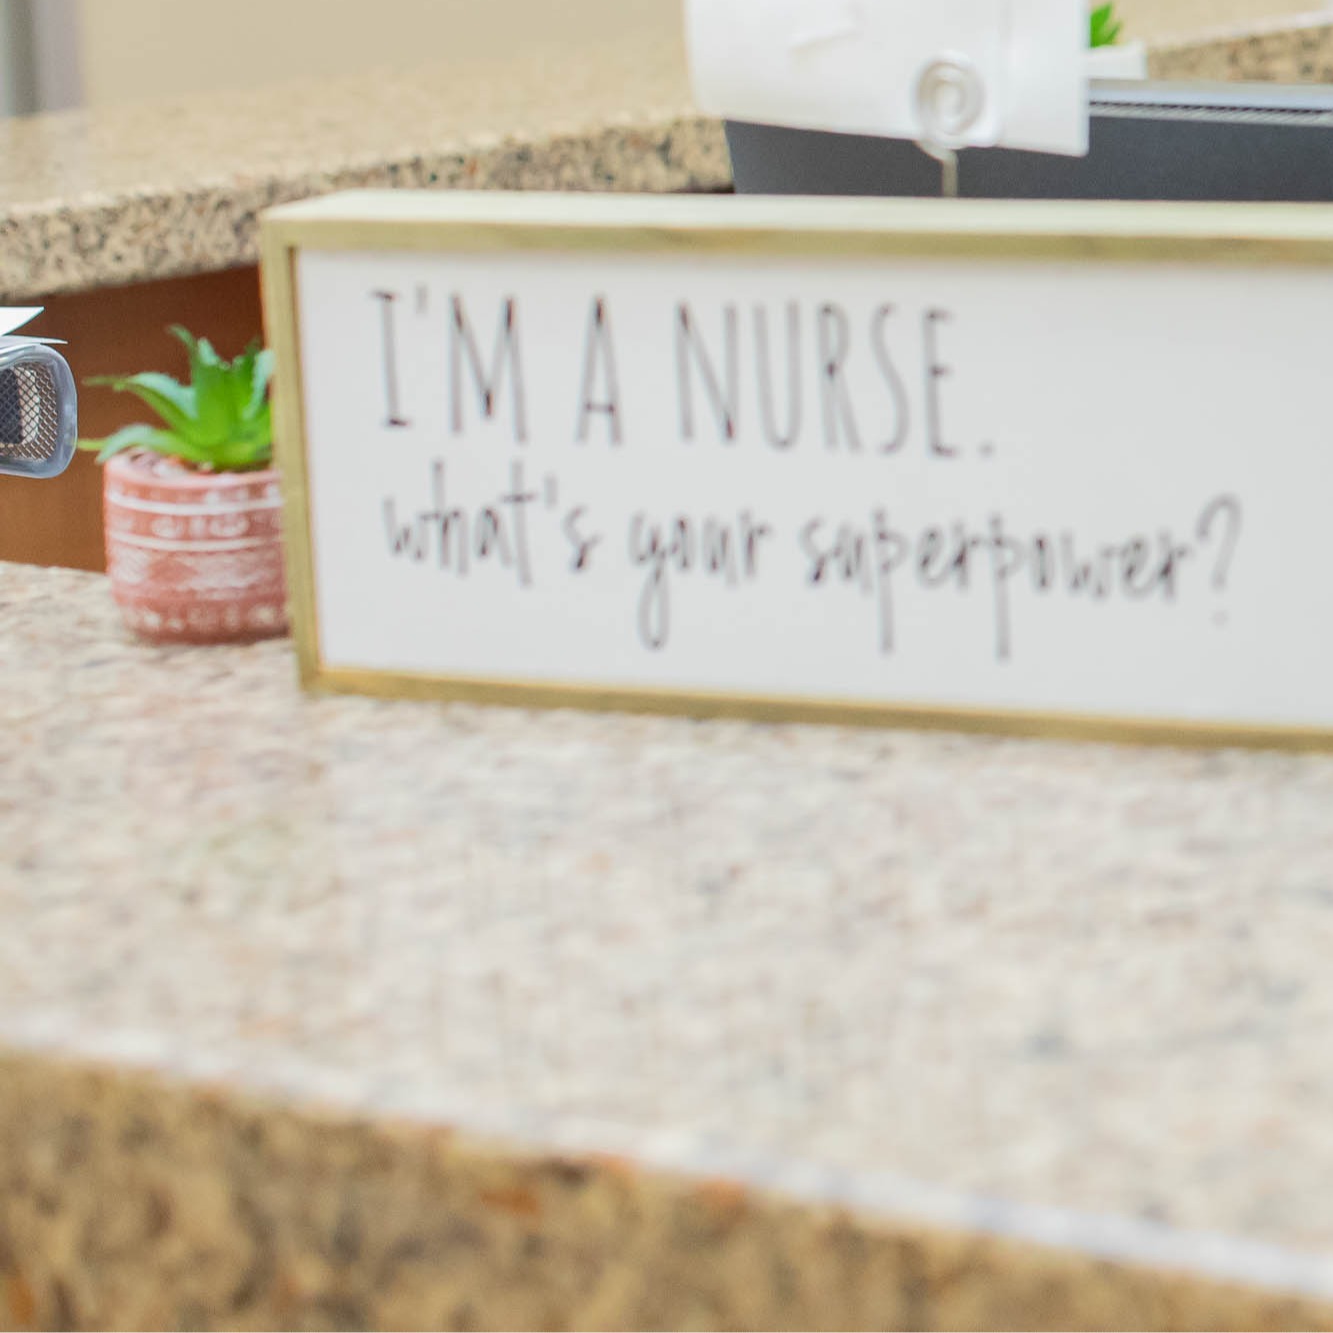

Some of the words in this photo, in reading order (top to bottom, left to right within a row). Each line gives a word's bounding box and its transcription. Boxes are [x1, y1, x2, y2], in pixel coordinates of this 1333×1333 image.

[370, 285, 529, 447] I'M
[573, 292, 625, 449] A
[674, 300, 998, 459] NURSE.
[381, 461, 602, 588] what's
[627, 506, 773, 651] your
[798, 493, 1243, 663] superpower?
